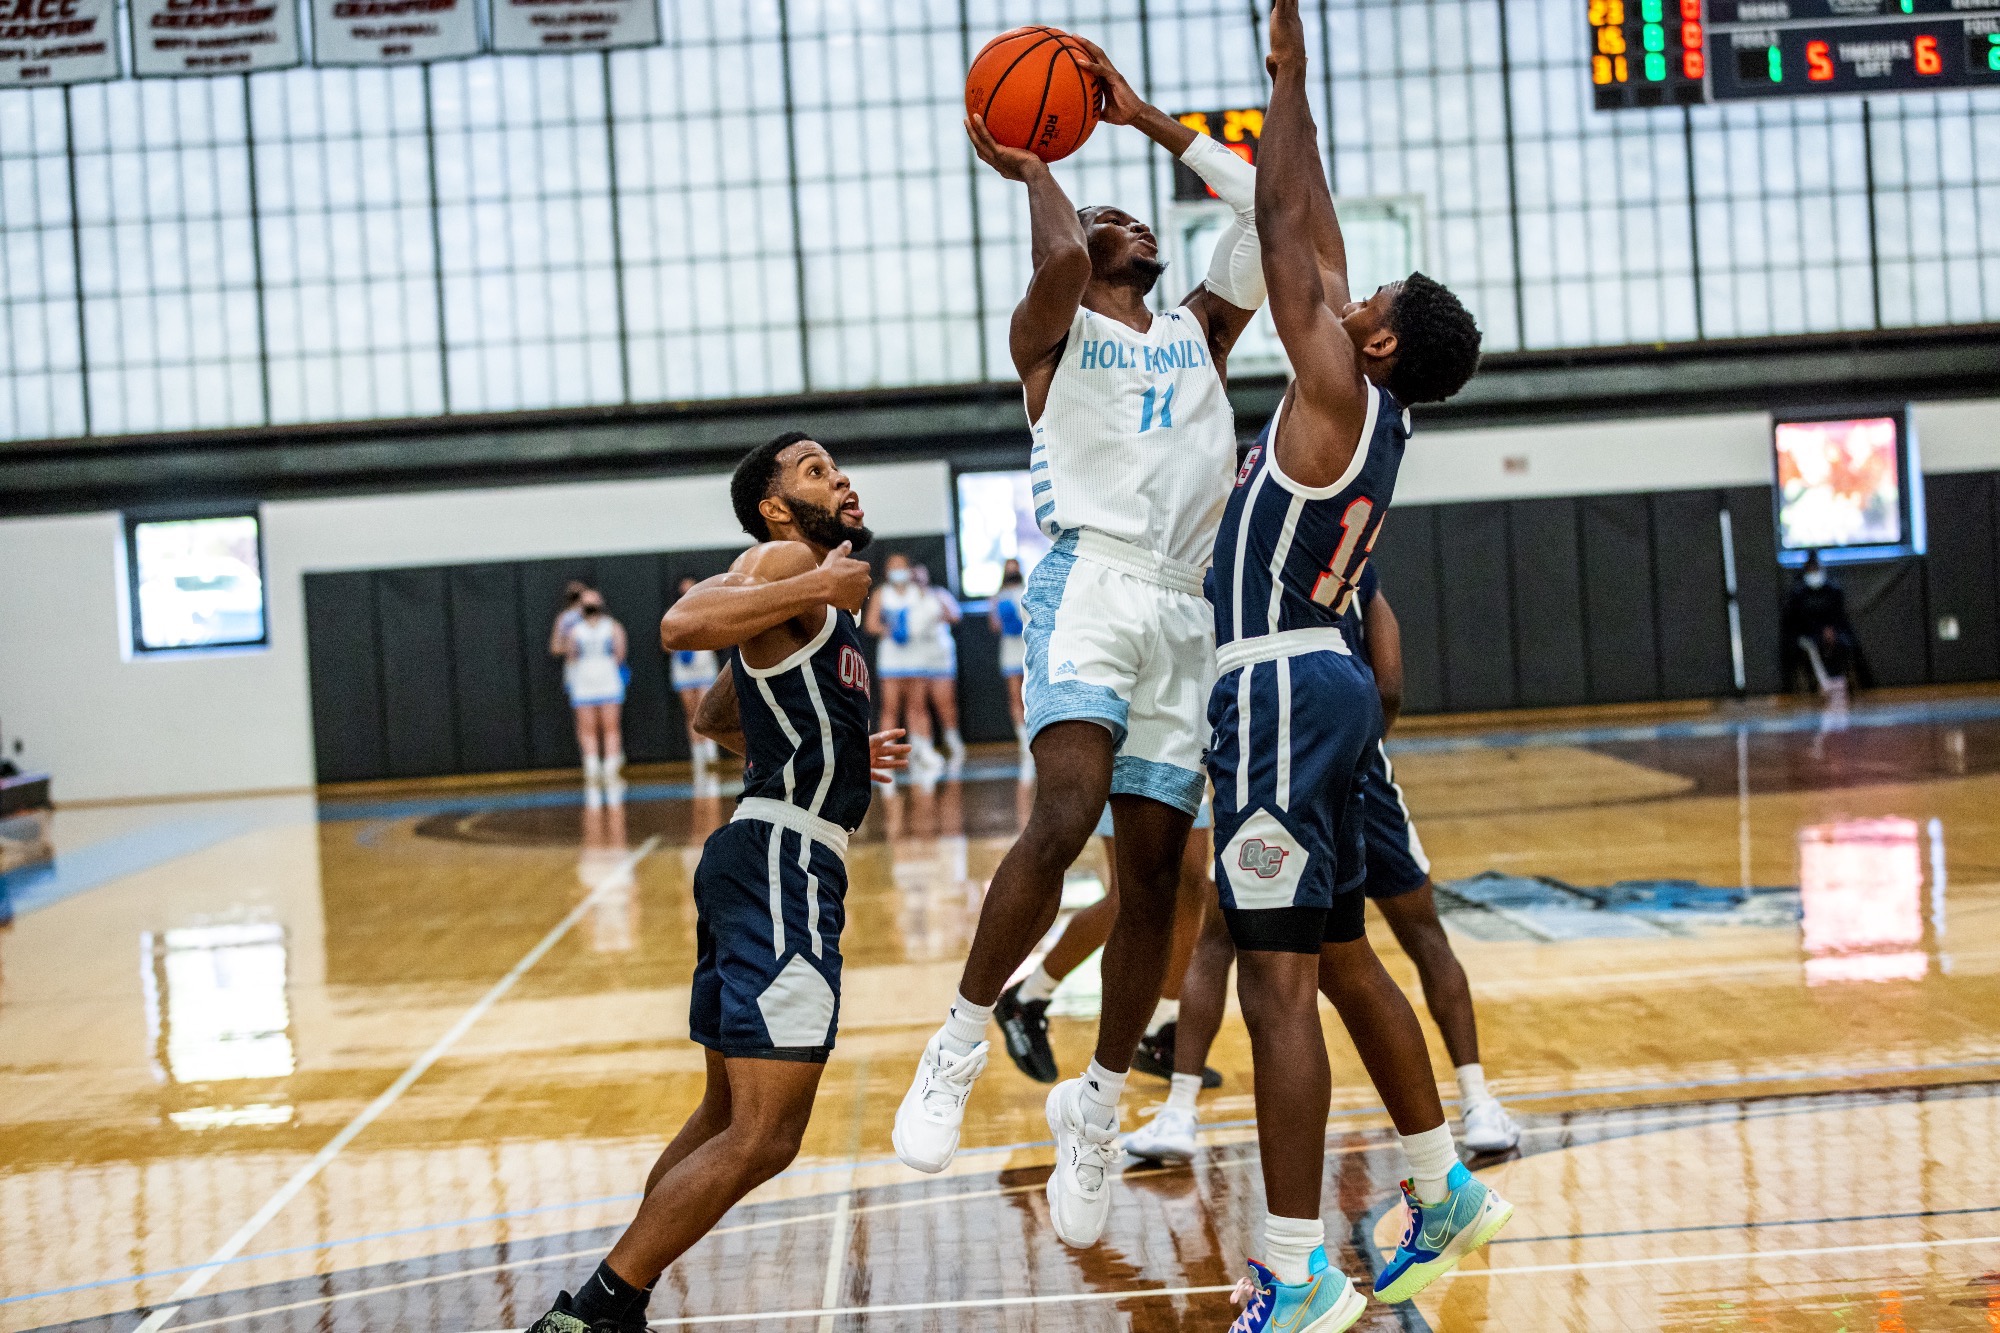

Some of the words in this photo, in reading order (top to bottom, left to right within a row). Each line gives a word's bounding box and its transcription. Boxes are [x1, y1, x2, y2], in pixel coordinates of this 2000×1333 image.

[1805, 40, 1835, 81] 5
[1914, 34, 1943, 75] 6
[1038, 114, 1059, 148] ROCK
[1138, 382, 1175, 434] 11
